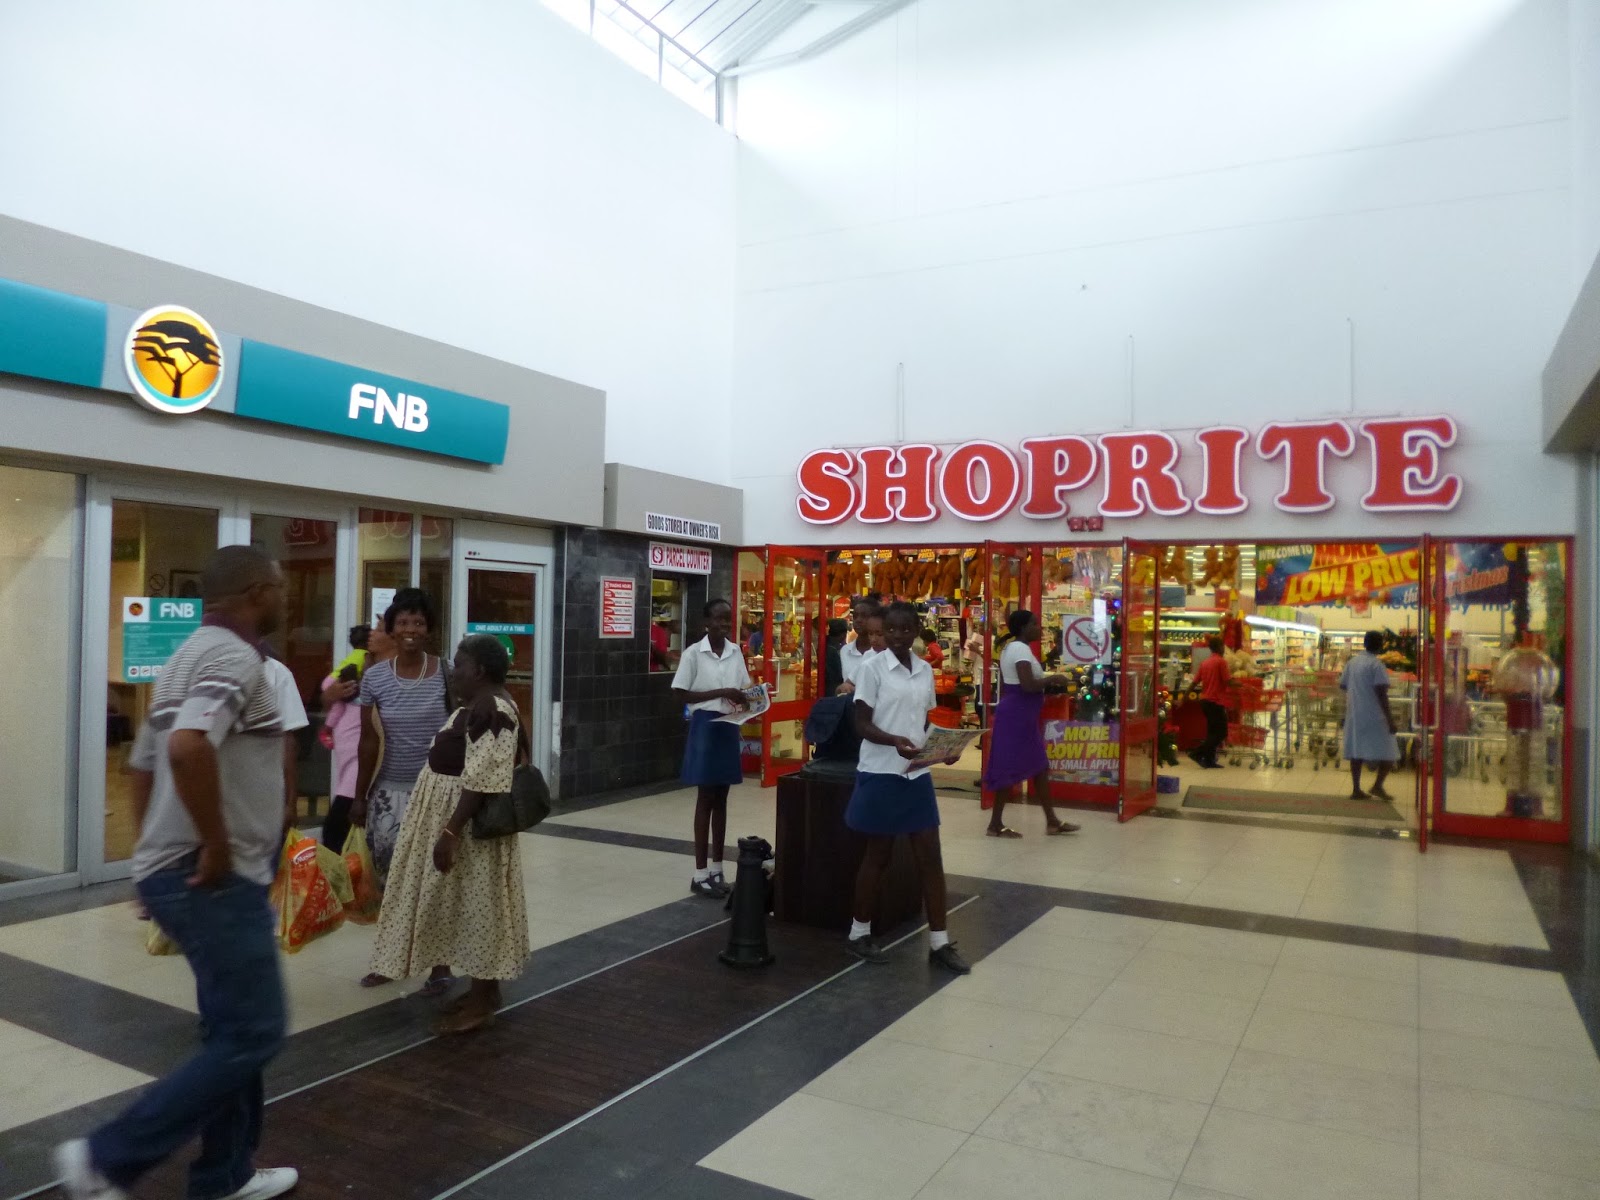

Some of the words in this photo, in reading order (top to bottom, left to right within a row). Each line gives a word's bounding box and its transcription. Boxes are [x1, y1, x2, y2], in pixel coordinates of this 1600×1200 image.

[349, 383, 429, 432] FNB
[796, 414, 1464, 526] SHOPRITE
[647, 514, 664, 531] GOODS
[665, 517, 682, 534] STORED
[683, 520, 688, 534] AT
[689, 521, 708, 538] OWNER'S
[709, 525, 719, 540] RISK
[666, 546, 685, 567] PARCEL
[687, 549, 710, 571] COUNTER
[1259, 545, 1300, 561] WELCOME
[1301, 544, 1313, 555] TO
[1285, 566, 1348, 604] LOW
[1353, 549, 1437, 591] PRIC
[1404, 586, 1419, 604] thi
[160, 602, 194, 618] FNB
[1064, 725, 1110, 741] MORE
[1046, 742, 1084, 759] LOW
[1060, 759, 1088, 770] SMALL
